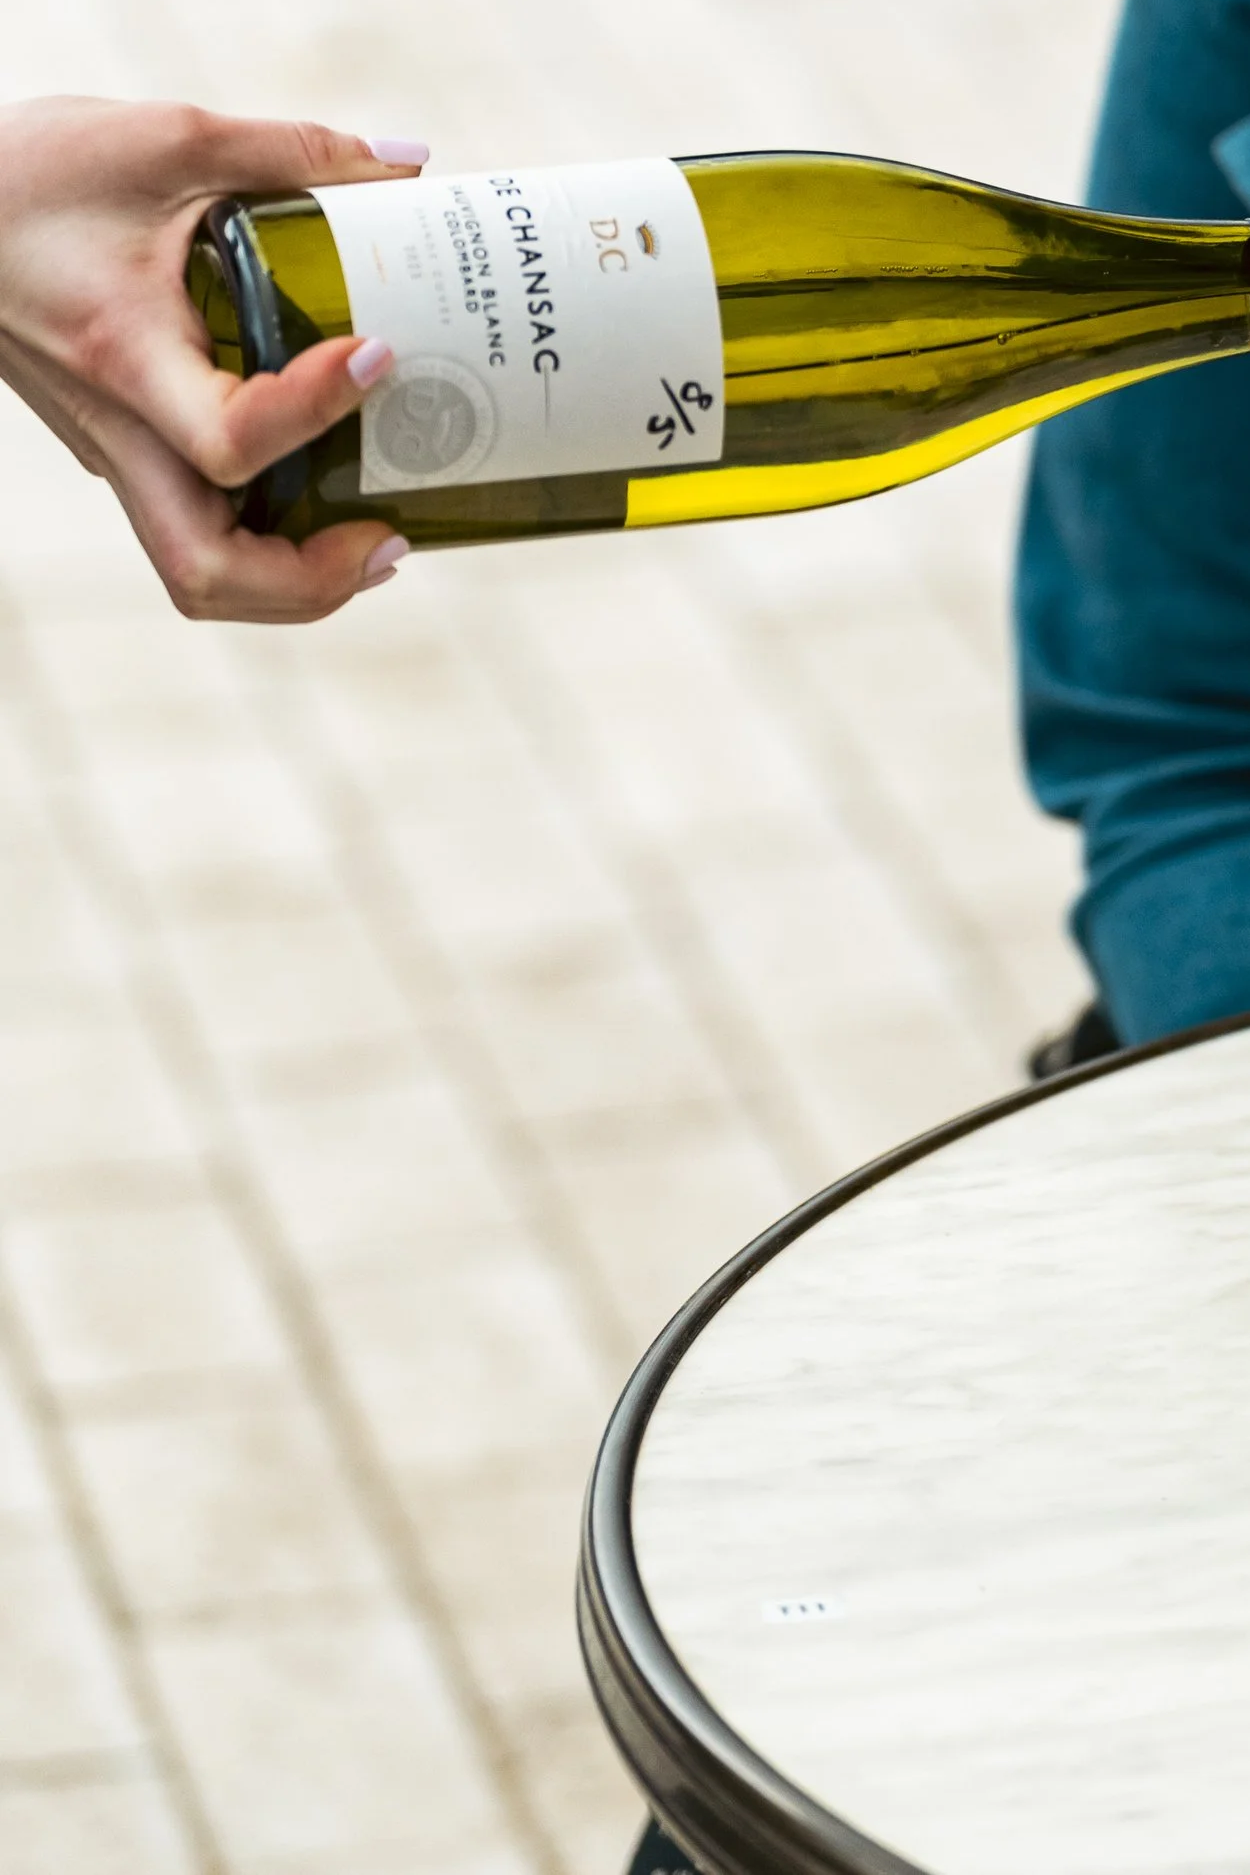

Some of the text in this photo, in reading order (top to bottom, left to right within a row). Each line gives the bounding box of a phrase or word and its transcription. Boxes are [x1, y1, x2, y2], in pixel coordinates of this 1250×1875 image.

[443, 210, 480, 314] COLOMBARD
[489, 177, 560, 374] DE CHANSAC
[480, 288, 506, 368] BLANC
